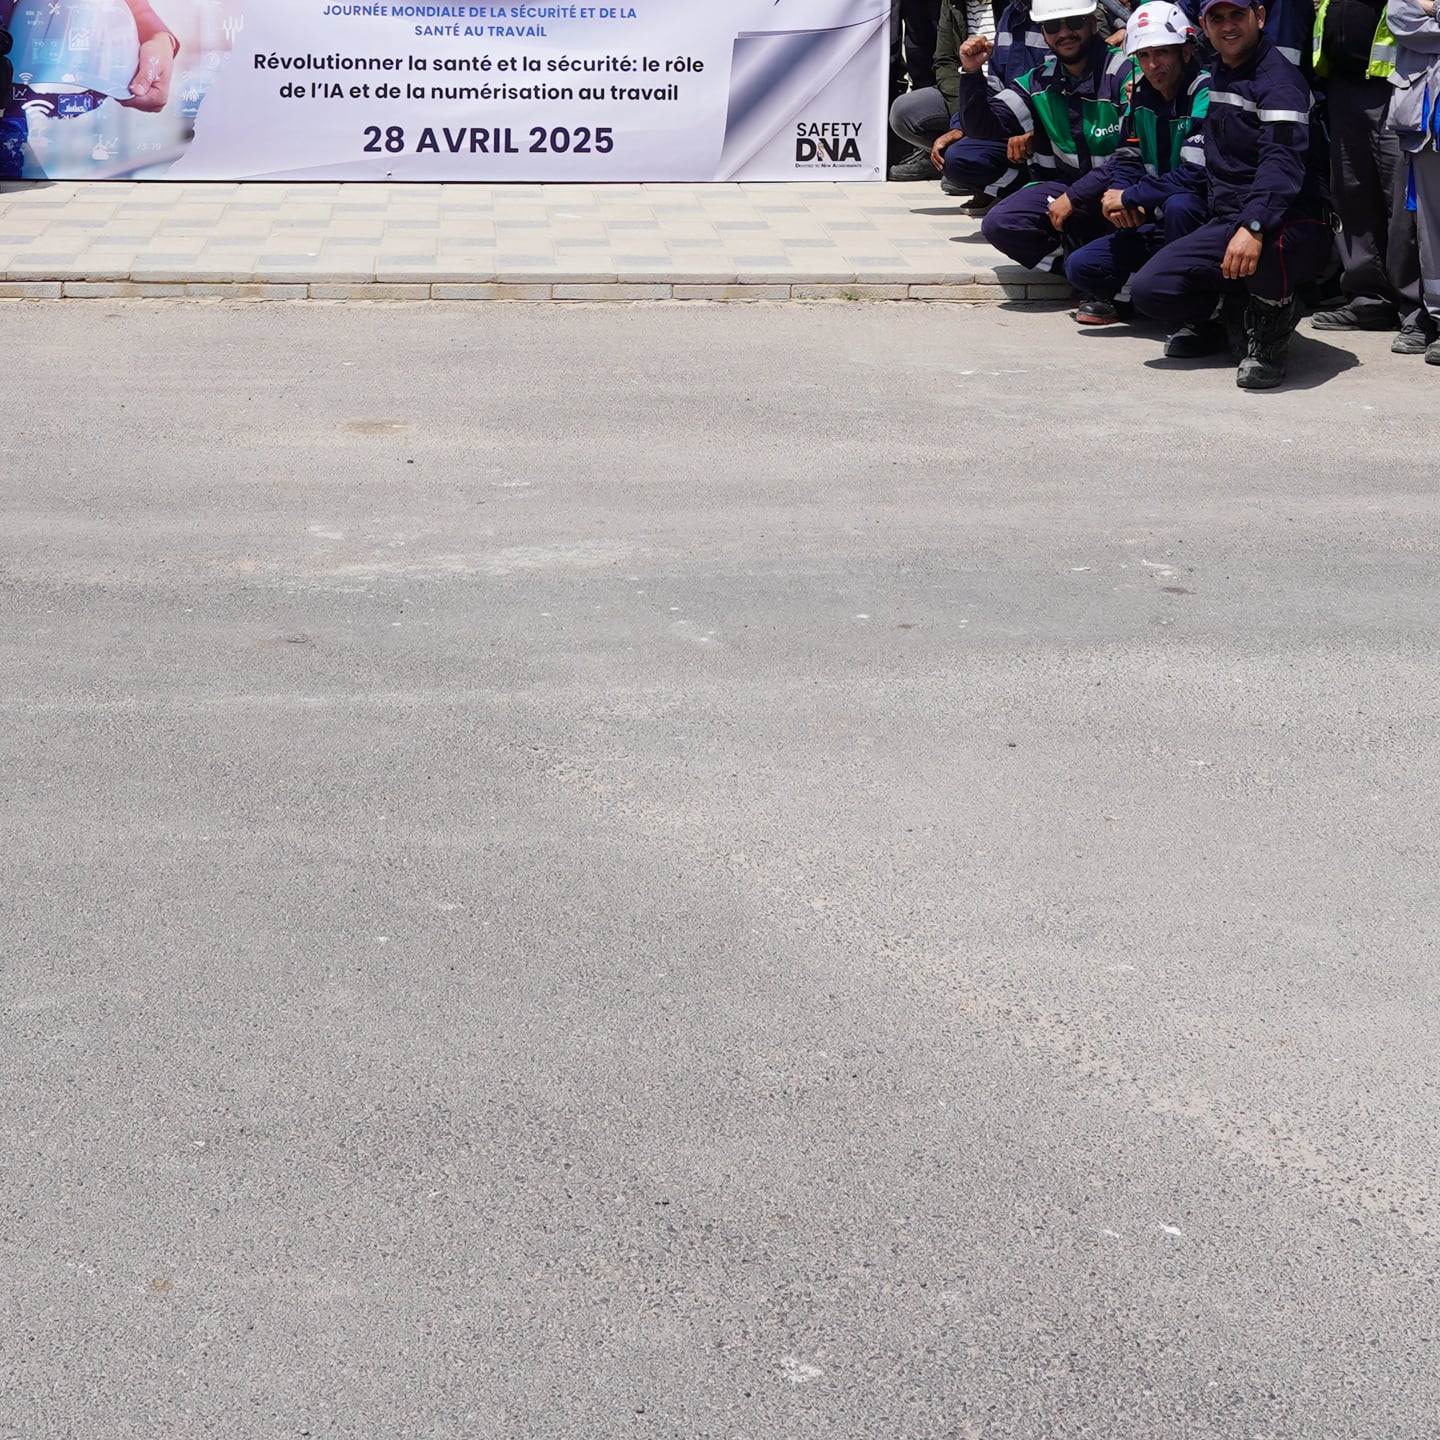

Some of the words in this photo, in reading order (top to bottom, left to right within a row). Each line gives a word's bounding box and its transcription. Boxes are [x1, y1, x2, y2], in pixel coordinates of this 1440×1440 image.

[323, 2, 388, 17] JOURNÉE
[391, 6, 466, 18] MONDIALE
[468, 6, 487, 18] DE
[490, 7, 507, 18] LA
[580, 7, 596, 19] ET
[599, 7, 617, 19] DE
[620, 7, 637, 19] LA
[414, 22, 460, 37] SANTÉ
[463, 25, 484, 37] AU
[253, 53, 404, 71] Révolutionner
[408, 55, 428, 71] la
[432, 54, 492, 72] santé
[497, 56, 518, 72] et
[523, 55, 542, 72] la
[547, 55, 637, 72] sécurité:
[642, 56, 660, 73] le
[665, 55, 705, 73] rôle
[279, 82, 306, 99] de
[349, 83, 370, 99] et
[374, 82, 401, 99] de
[406, 83, 426, 100] la
[431, 82, 573, 100] numérisation
[578, 87, 605, 100] au
[610, 83, 679, 101] travail
[796, 122, 863, 137] SAFETY
[363, 125, 405, 153] 28
[415, 126, 519, 153] AVRIL
[528, 126, 614, 154] 2025
[795, 138, 862, 162] DNA
